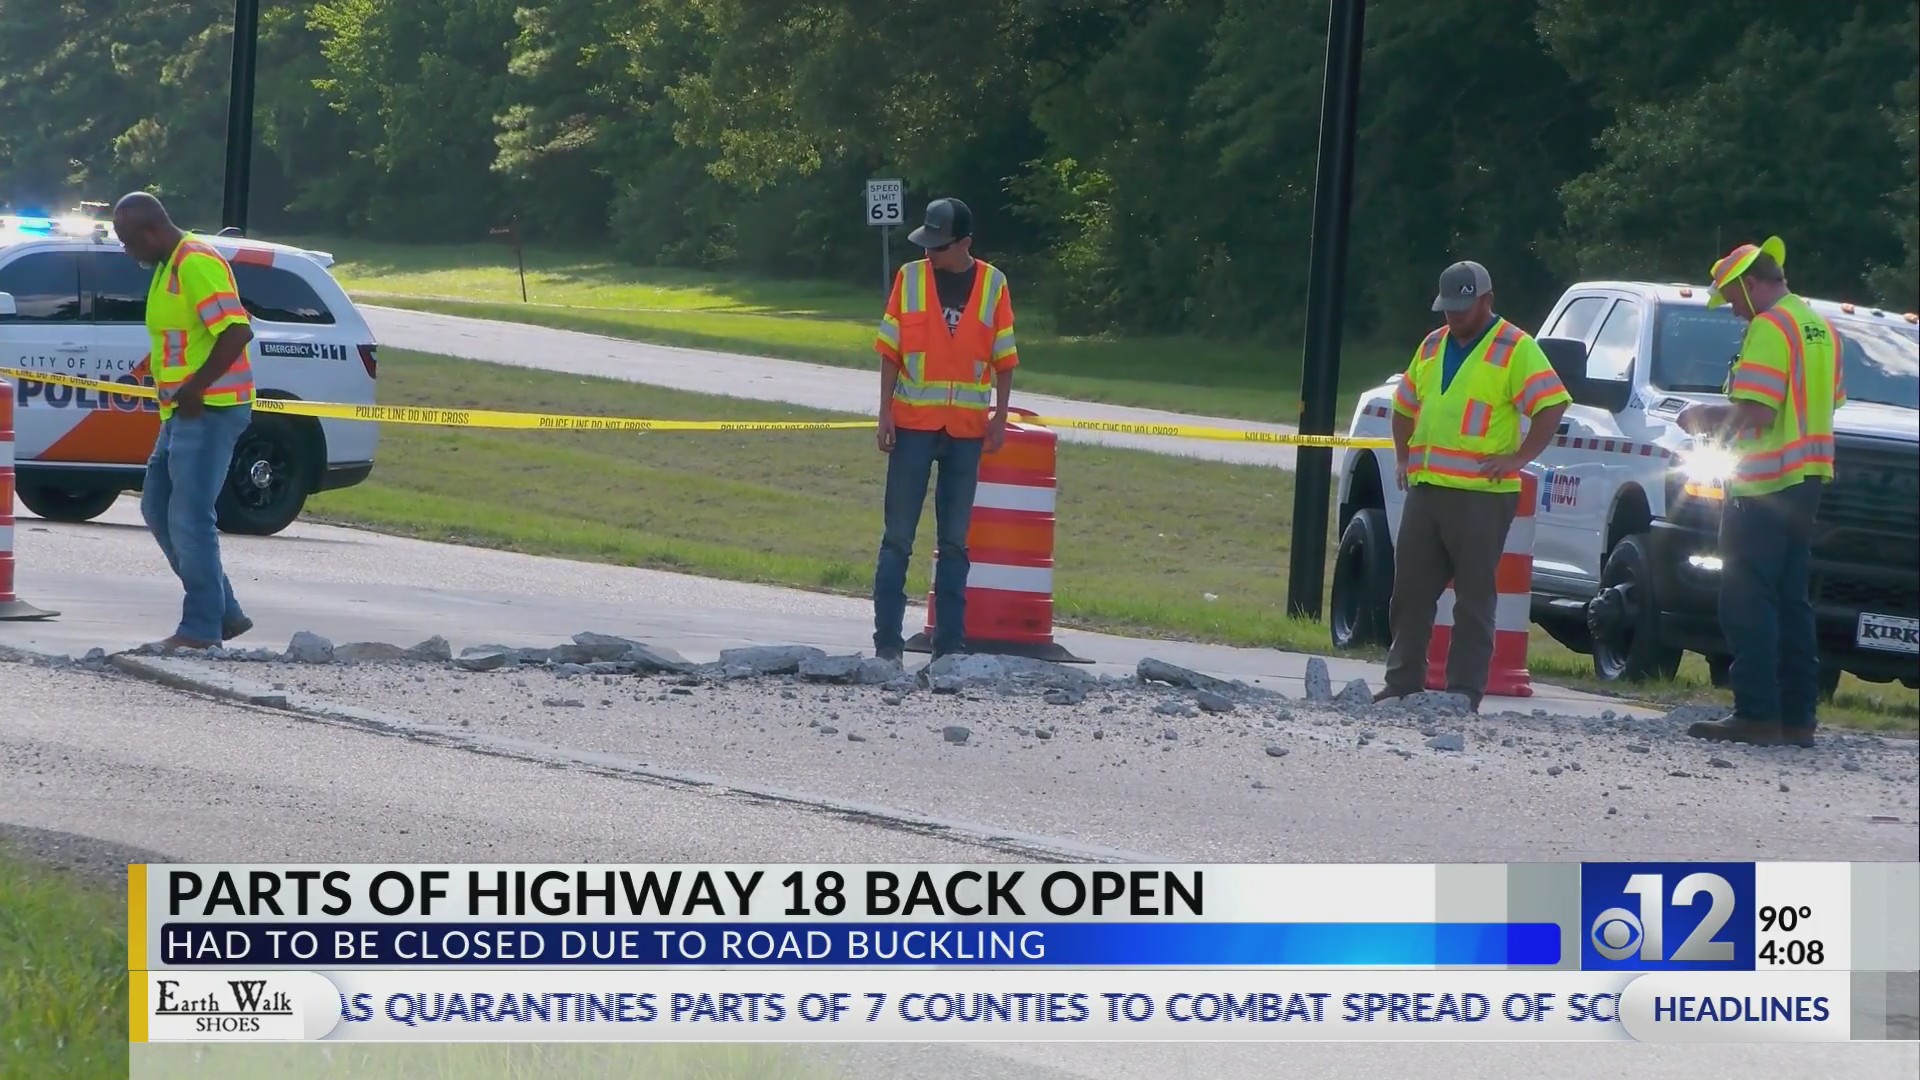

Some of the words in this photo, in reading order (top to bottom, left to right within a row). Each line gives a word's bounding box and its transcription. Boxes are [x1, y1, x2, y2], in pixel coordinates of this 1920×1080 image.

[870, 184, 900, 192] SPEED
[871, 203, 899, 219] 65
[264, 344, 310, 355] EMERGENCY
[311, 343, 347, 360] 911
[20, 356, 56, 368] CITY
[67, 358, 85, 368] OF
[356, 406, 385, 418] POLICE
[387, 409, 406, 420] LINE
[408, 409, 419, 421] DO
[422, 410, 438, 422] NOT
[441, 412, 469, 424] CROSS
[540, 418, 568, 427] POLICE
[571, 419, 589, 427] LINE
[605, 421, 622, 429] NOT
[1861, 623, 1919, 644] KIRK
